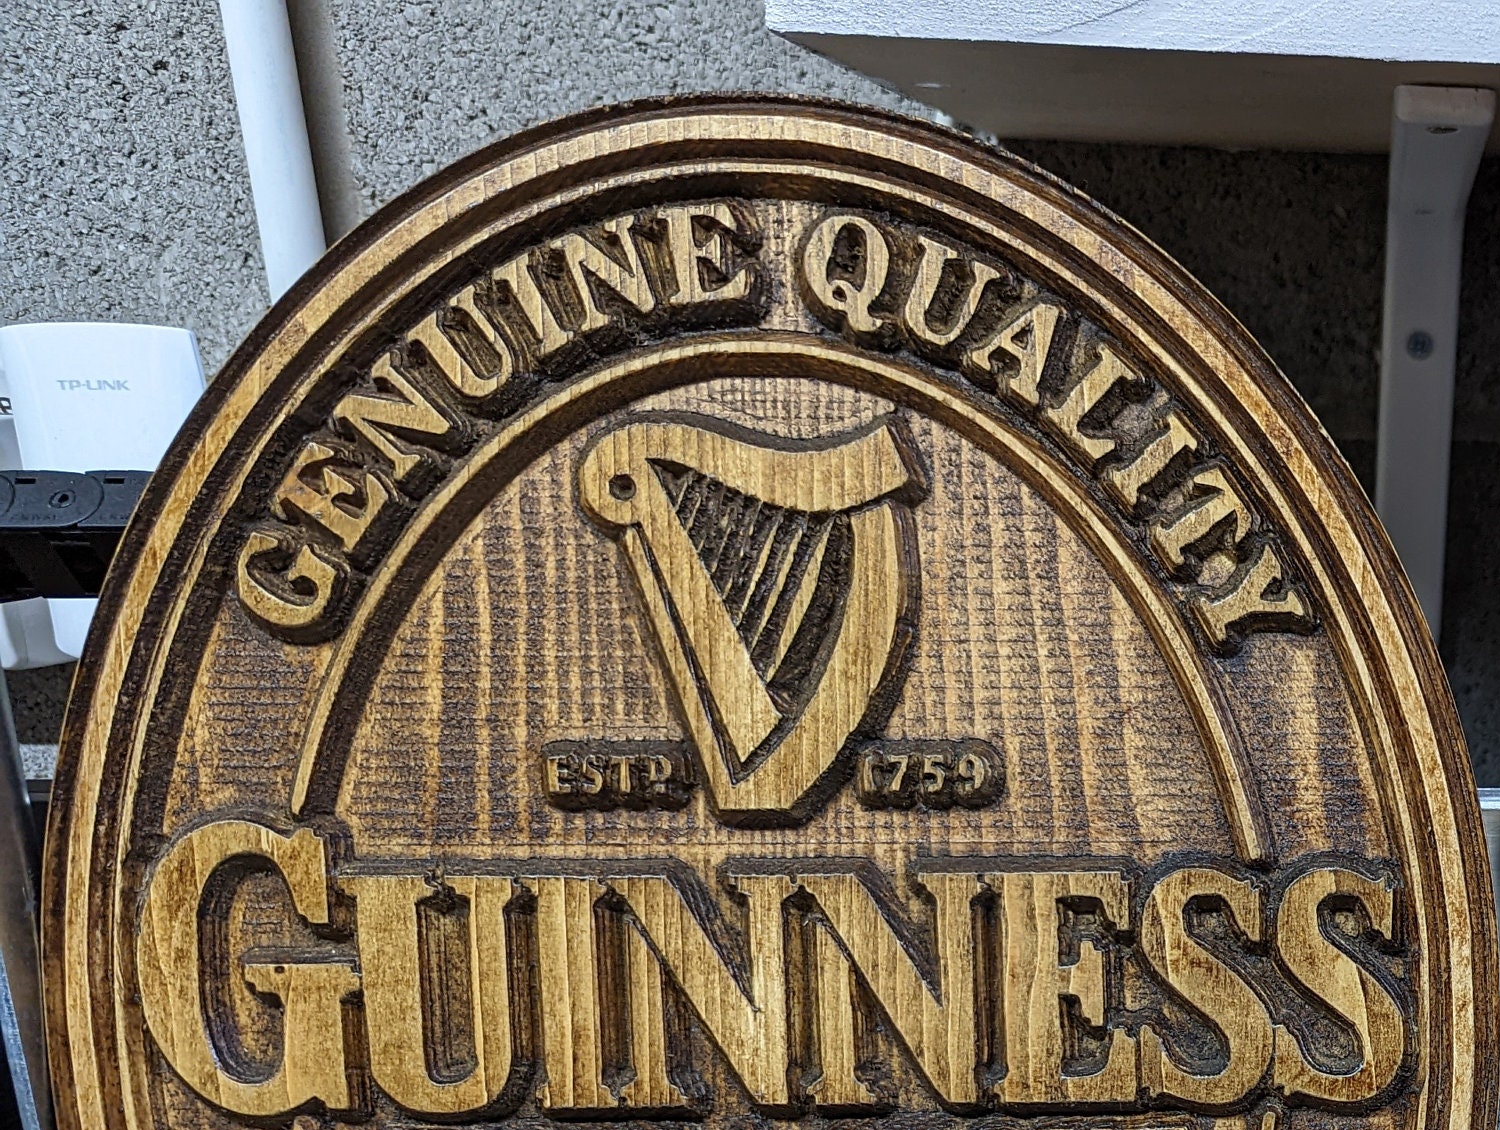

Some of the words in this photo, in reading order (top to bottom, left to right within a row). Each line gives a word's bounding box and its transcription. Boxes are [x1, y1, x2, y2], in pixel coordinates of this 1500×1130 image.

[56, 379, 130, 391] TP-LINK
[237, 203, 757, 627] GENUINE
[804, 215, 1304, 645] QUALITY
[862, 753, 985, 793] 1759
[137, 820, 1404, 1115] GUINNESS
